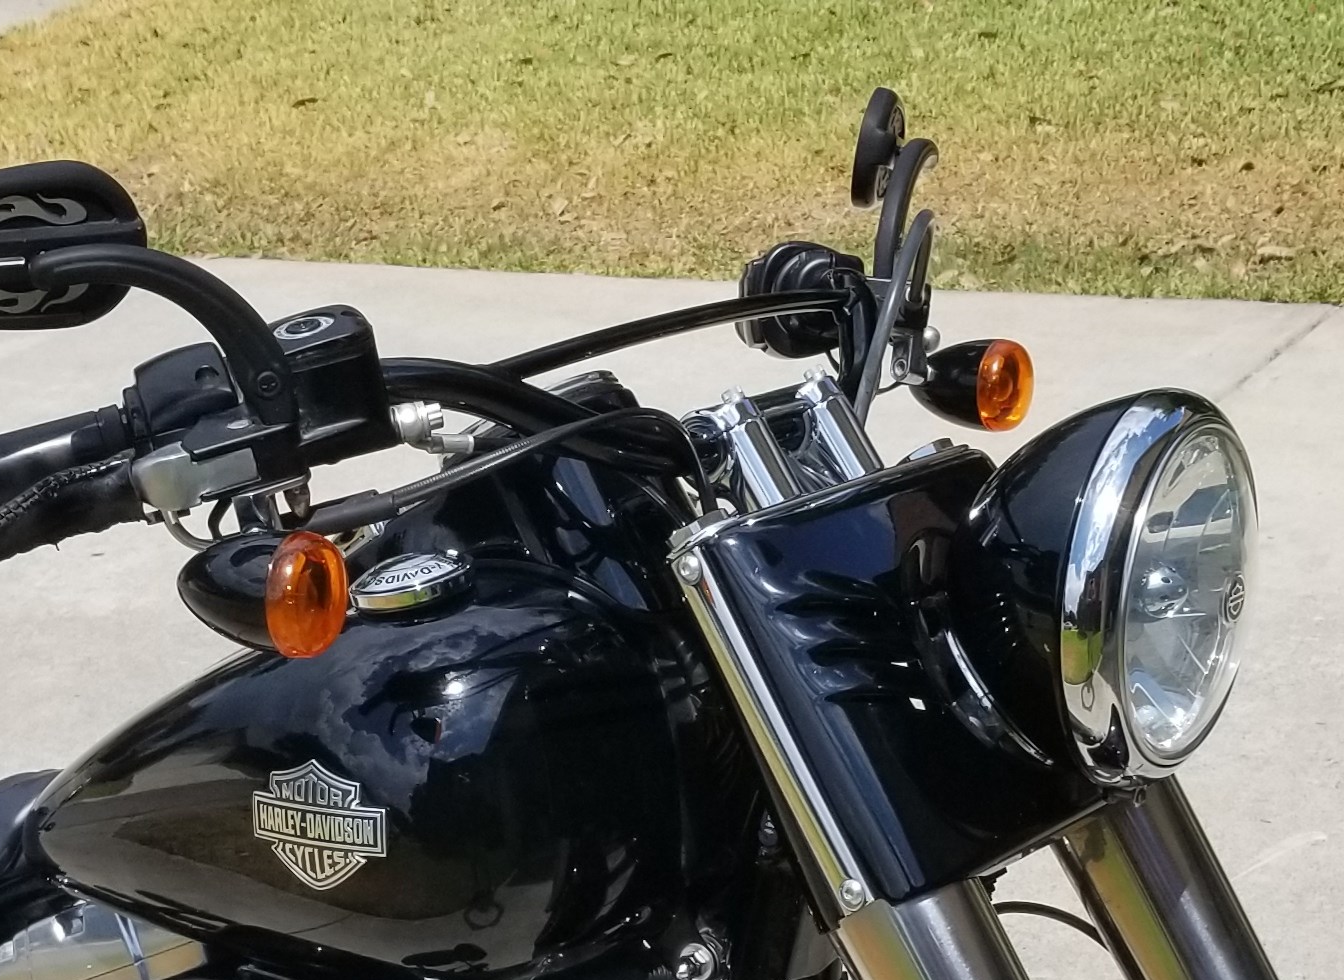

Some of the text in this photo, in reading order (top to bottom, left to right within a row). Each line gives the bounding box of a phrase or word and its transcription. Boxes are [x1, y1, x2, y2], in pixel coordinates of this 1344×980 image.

[281, 773, 343, 808] MOTOR
[258, 803, 375, 846] HARLEY-DAVIDSON
[283, 842, 346, 880] CYCLES
